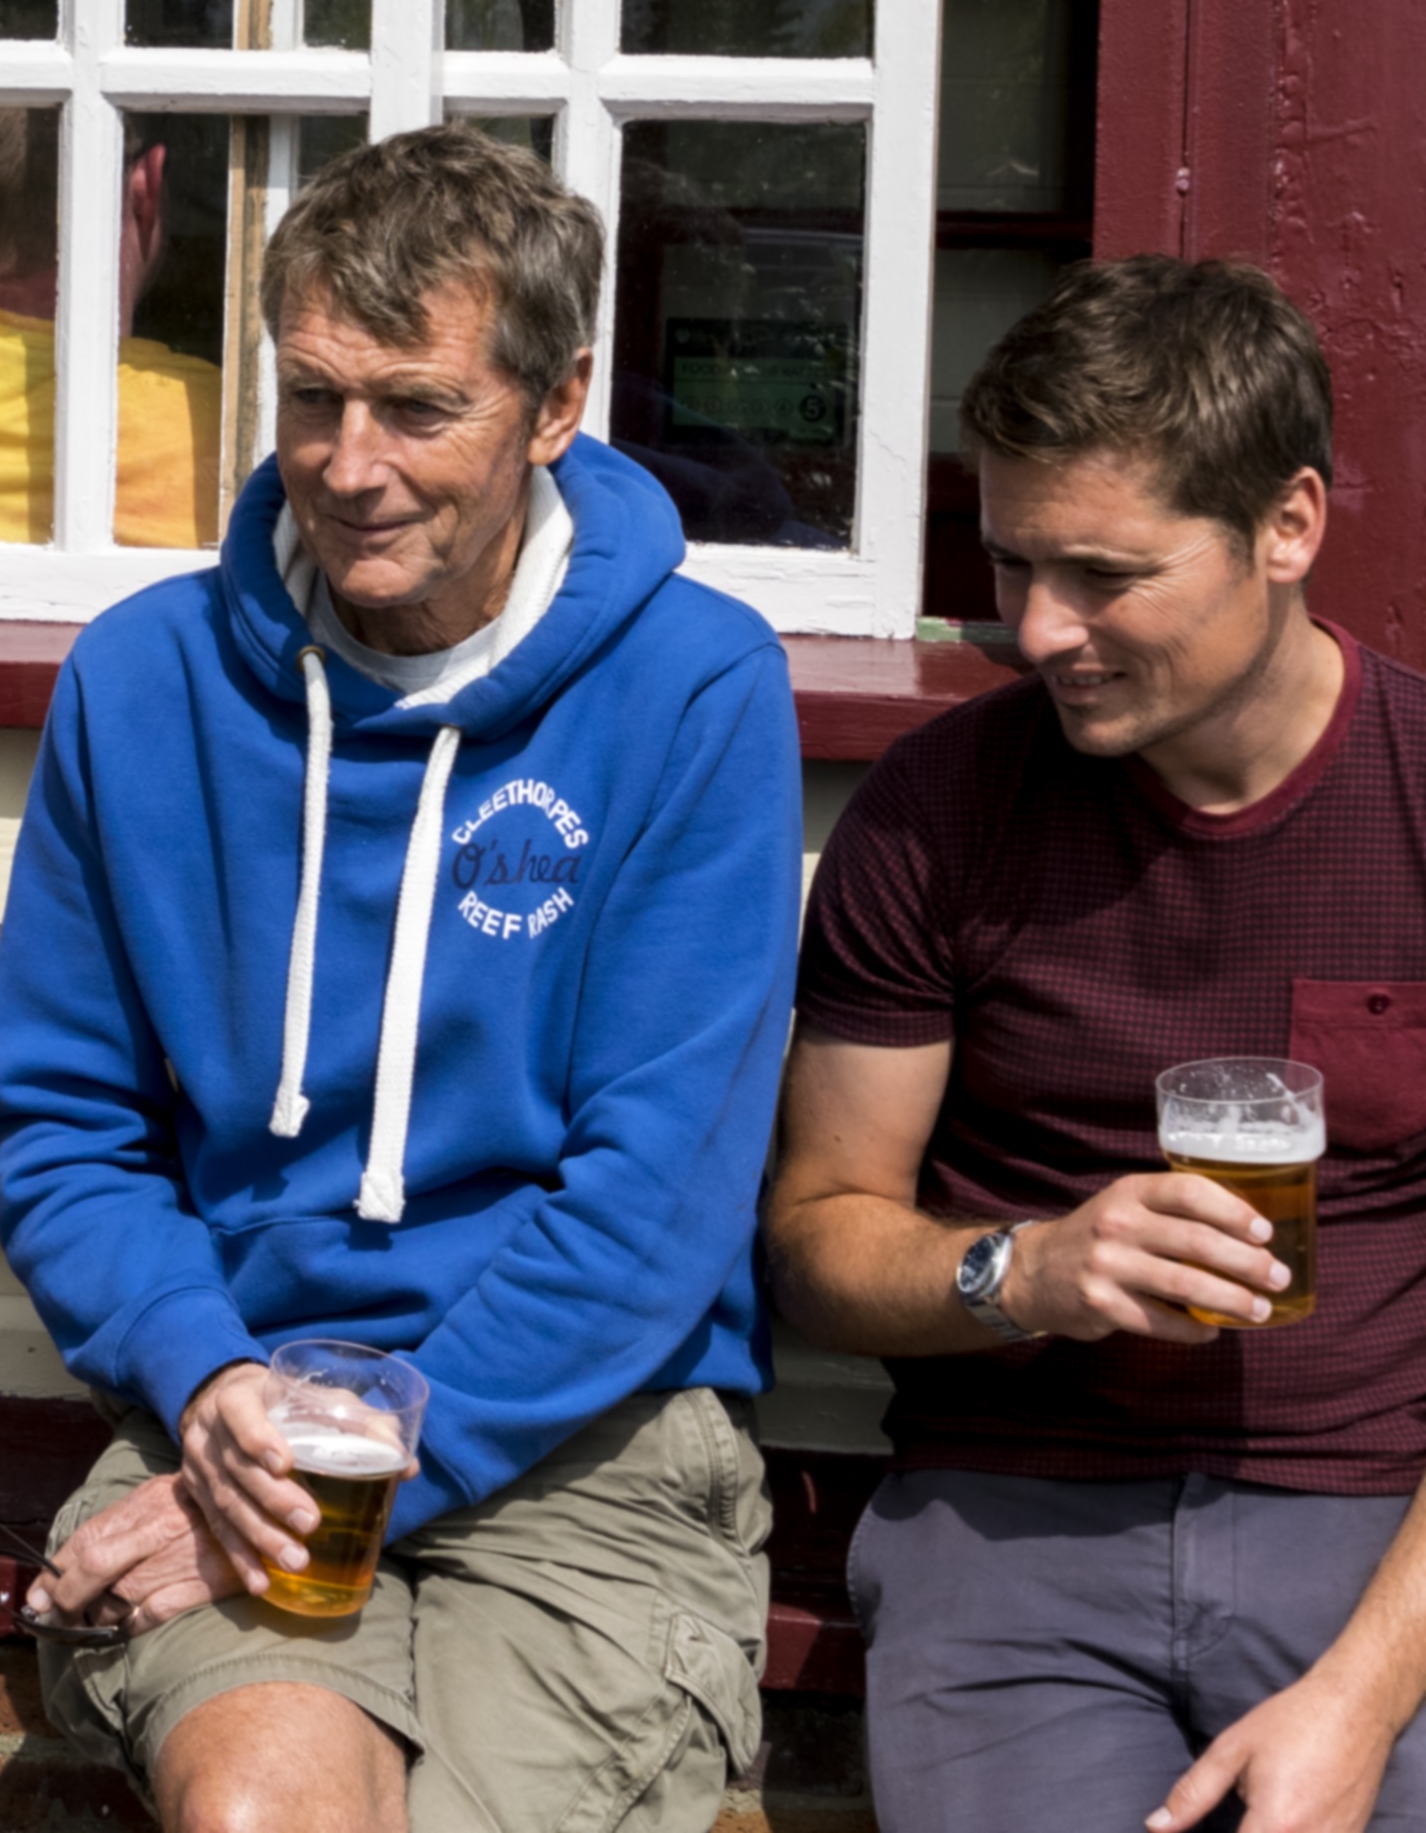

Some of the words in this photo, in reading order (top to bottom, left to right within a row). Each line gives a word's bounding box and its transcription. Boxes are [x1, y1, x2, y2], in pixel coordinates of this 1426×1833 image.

[805, 398, 821, 419] 5
[451, 778, 589, 849] CLEETHORPES
[457, 890, 522, 940] REEF
[527, 887, 575, 939] RASH
